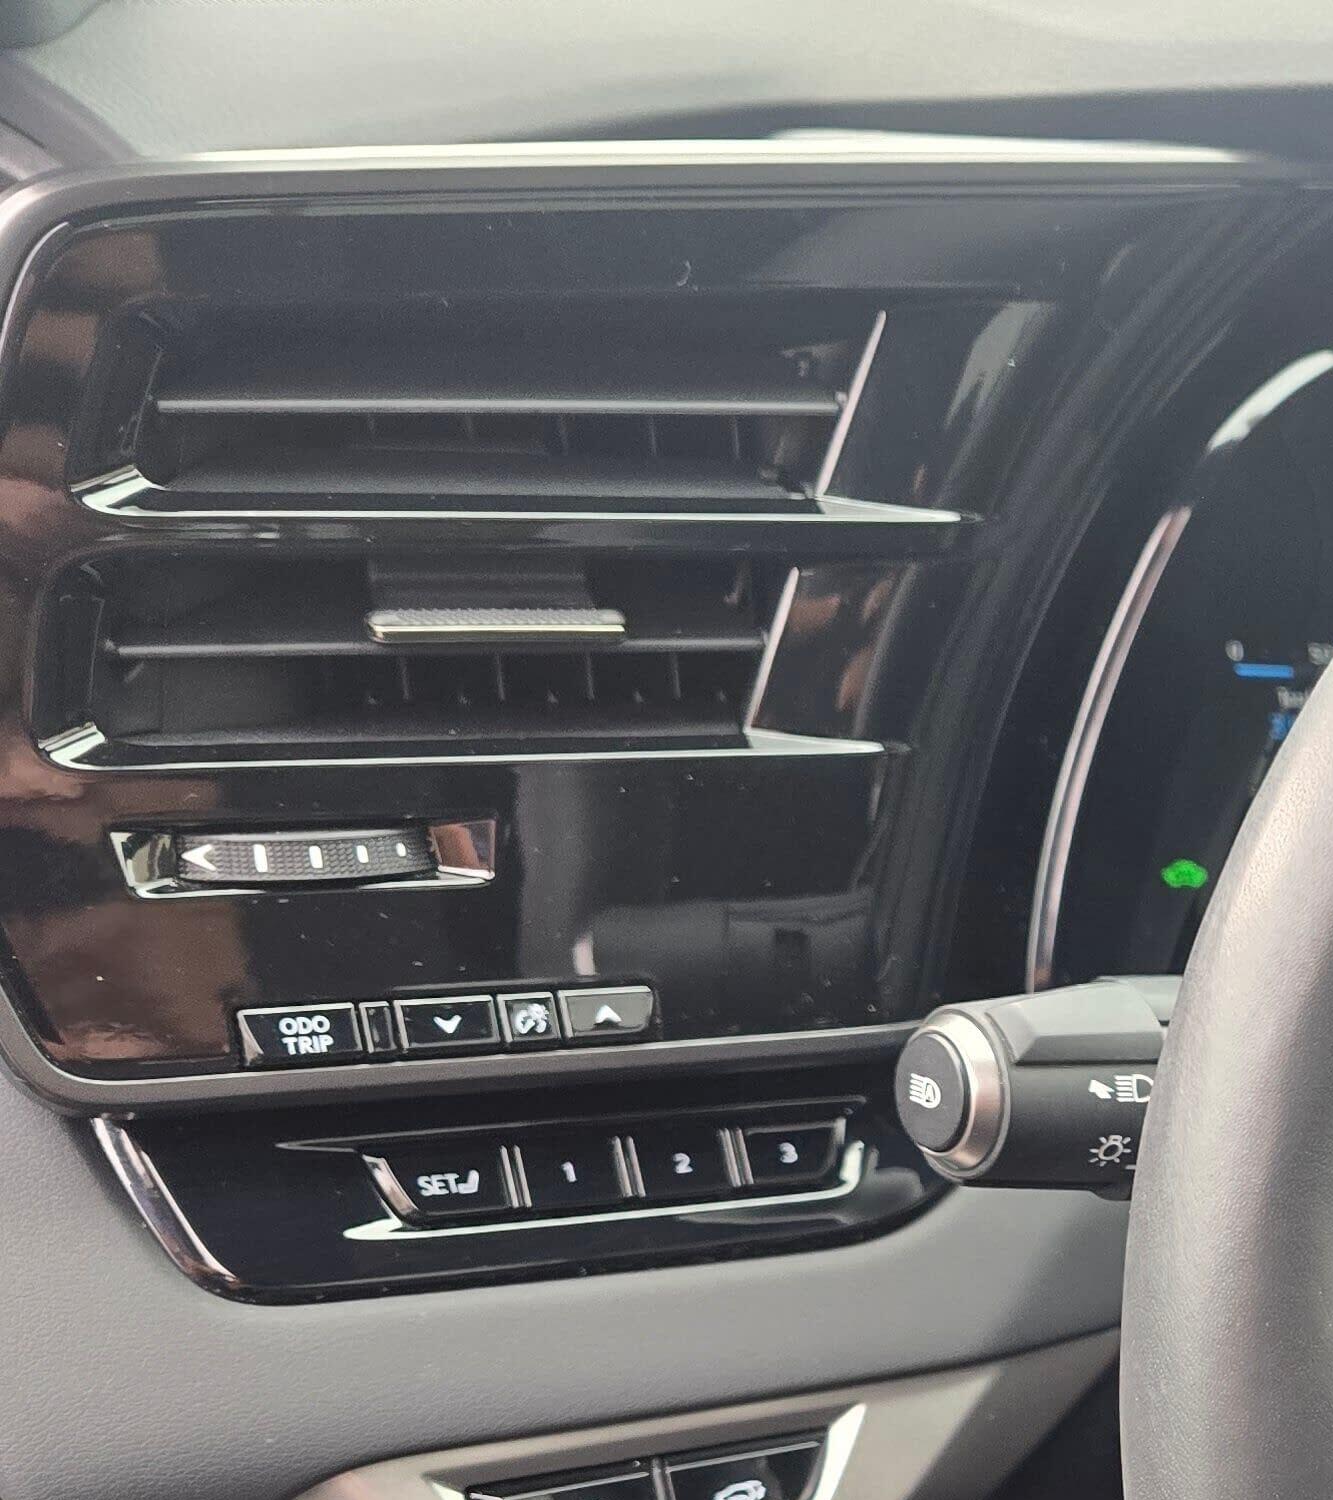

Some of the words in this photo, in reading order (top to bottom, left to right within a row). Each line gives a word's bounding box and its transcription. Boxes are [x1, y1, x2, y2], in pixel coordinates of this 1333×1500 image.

[279, 1015, 331, 1036] ODO
[282, 1034, 334, 1055] TRIP
[673, 1153, 692, 1174] 2
[779, 1142, 798, 1164] 3
[561, 1161, 577, 1183] 1
[416, 1173, 459, 1196] SET
